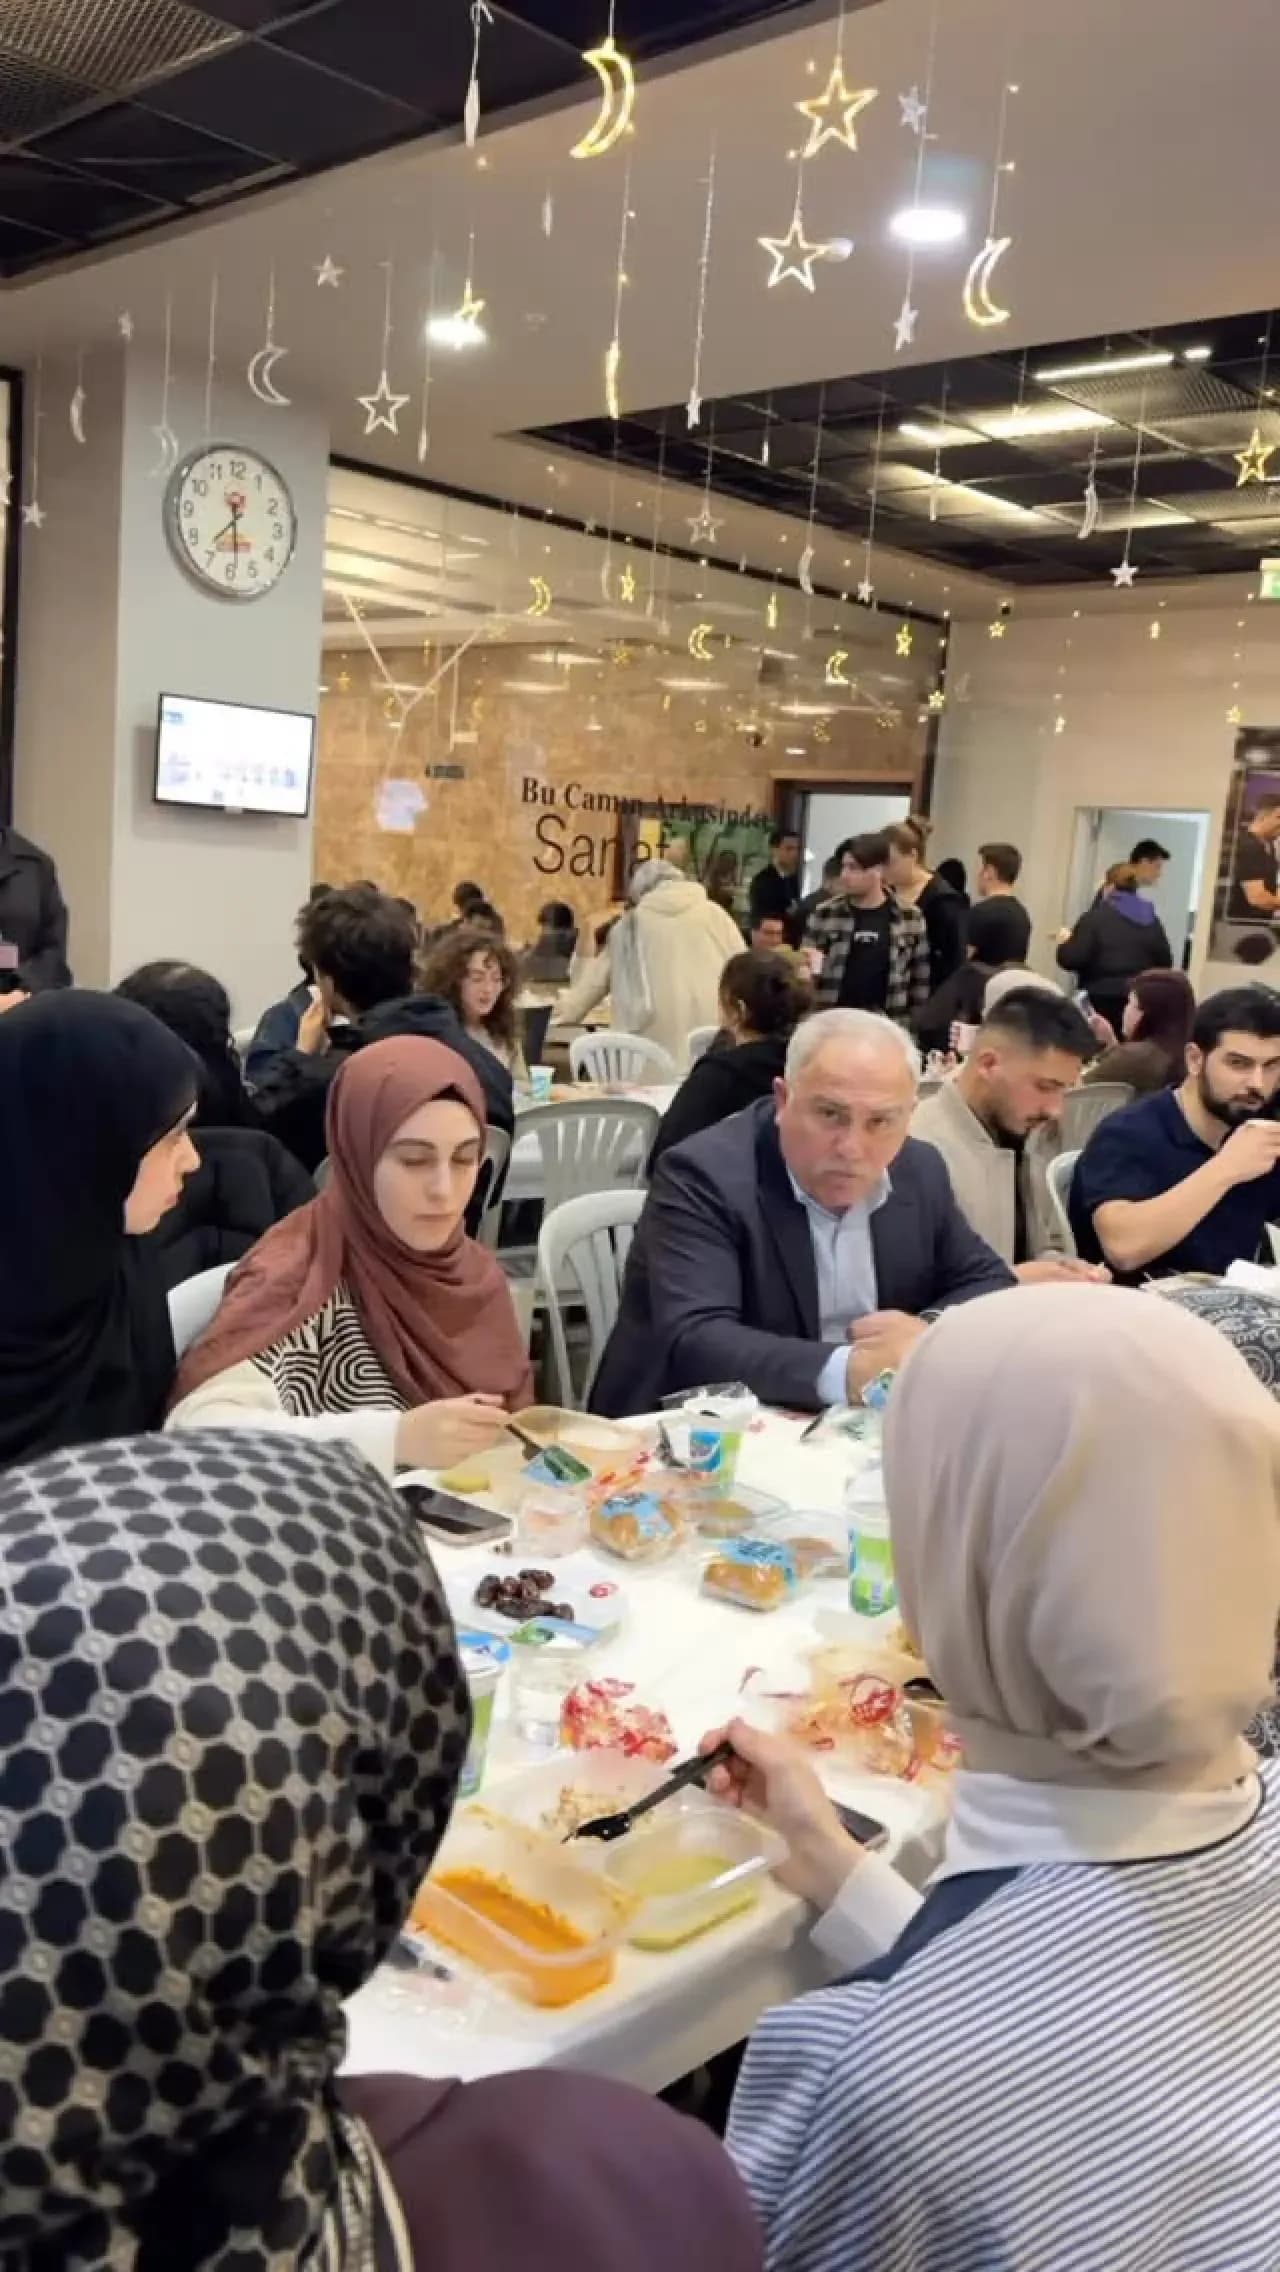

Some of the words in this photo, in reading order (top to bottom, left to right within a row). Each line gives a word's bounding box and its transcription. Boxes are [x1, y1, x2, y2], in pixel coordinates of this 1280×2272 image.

[209, 463, 223, 481] 11
[229, 460, 247, 481] 12
[191, 479, 209, 497] 10
[255, 474, 263, 492] 1
[183, 499, 195, 519] 9
[266, 497, 279, 516] 2
[188, 527, 199, 547] 8
[271, 521, 283, 541] 3
[205, 550, 216, 568] 7
[263, 546, 275, 563] 4
[224, 563, 237, 581] 6
[247, 560, 258, 579] 5
[521, 776, 555, 806] Bu
